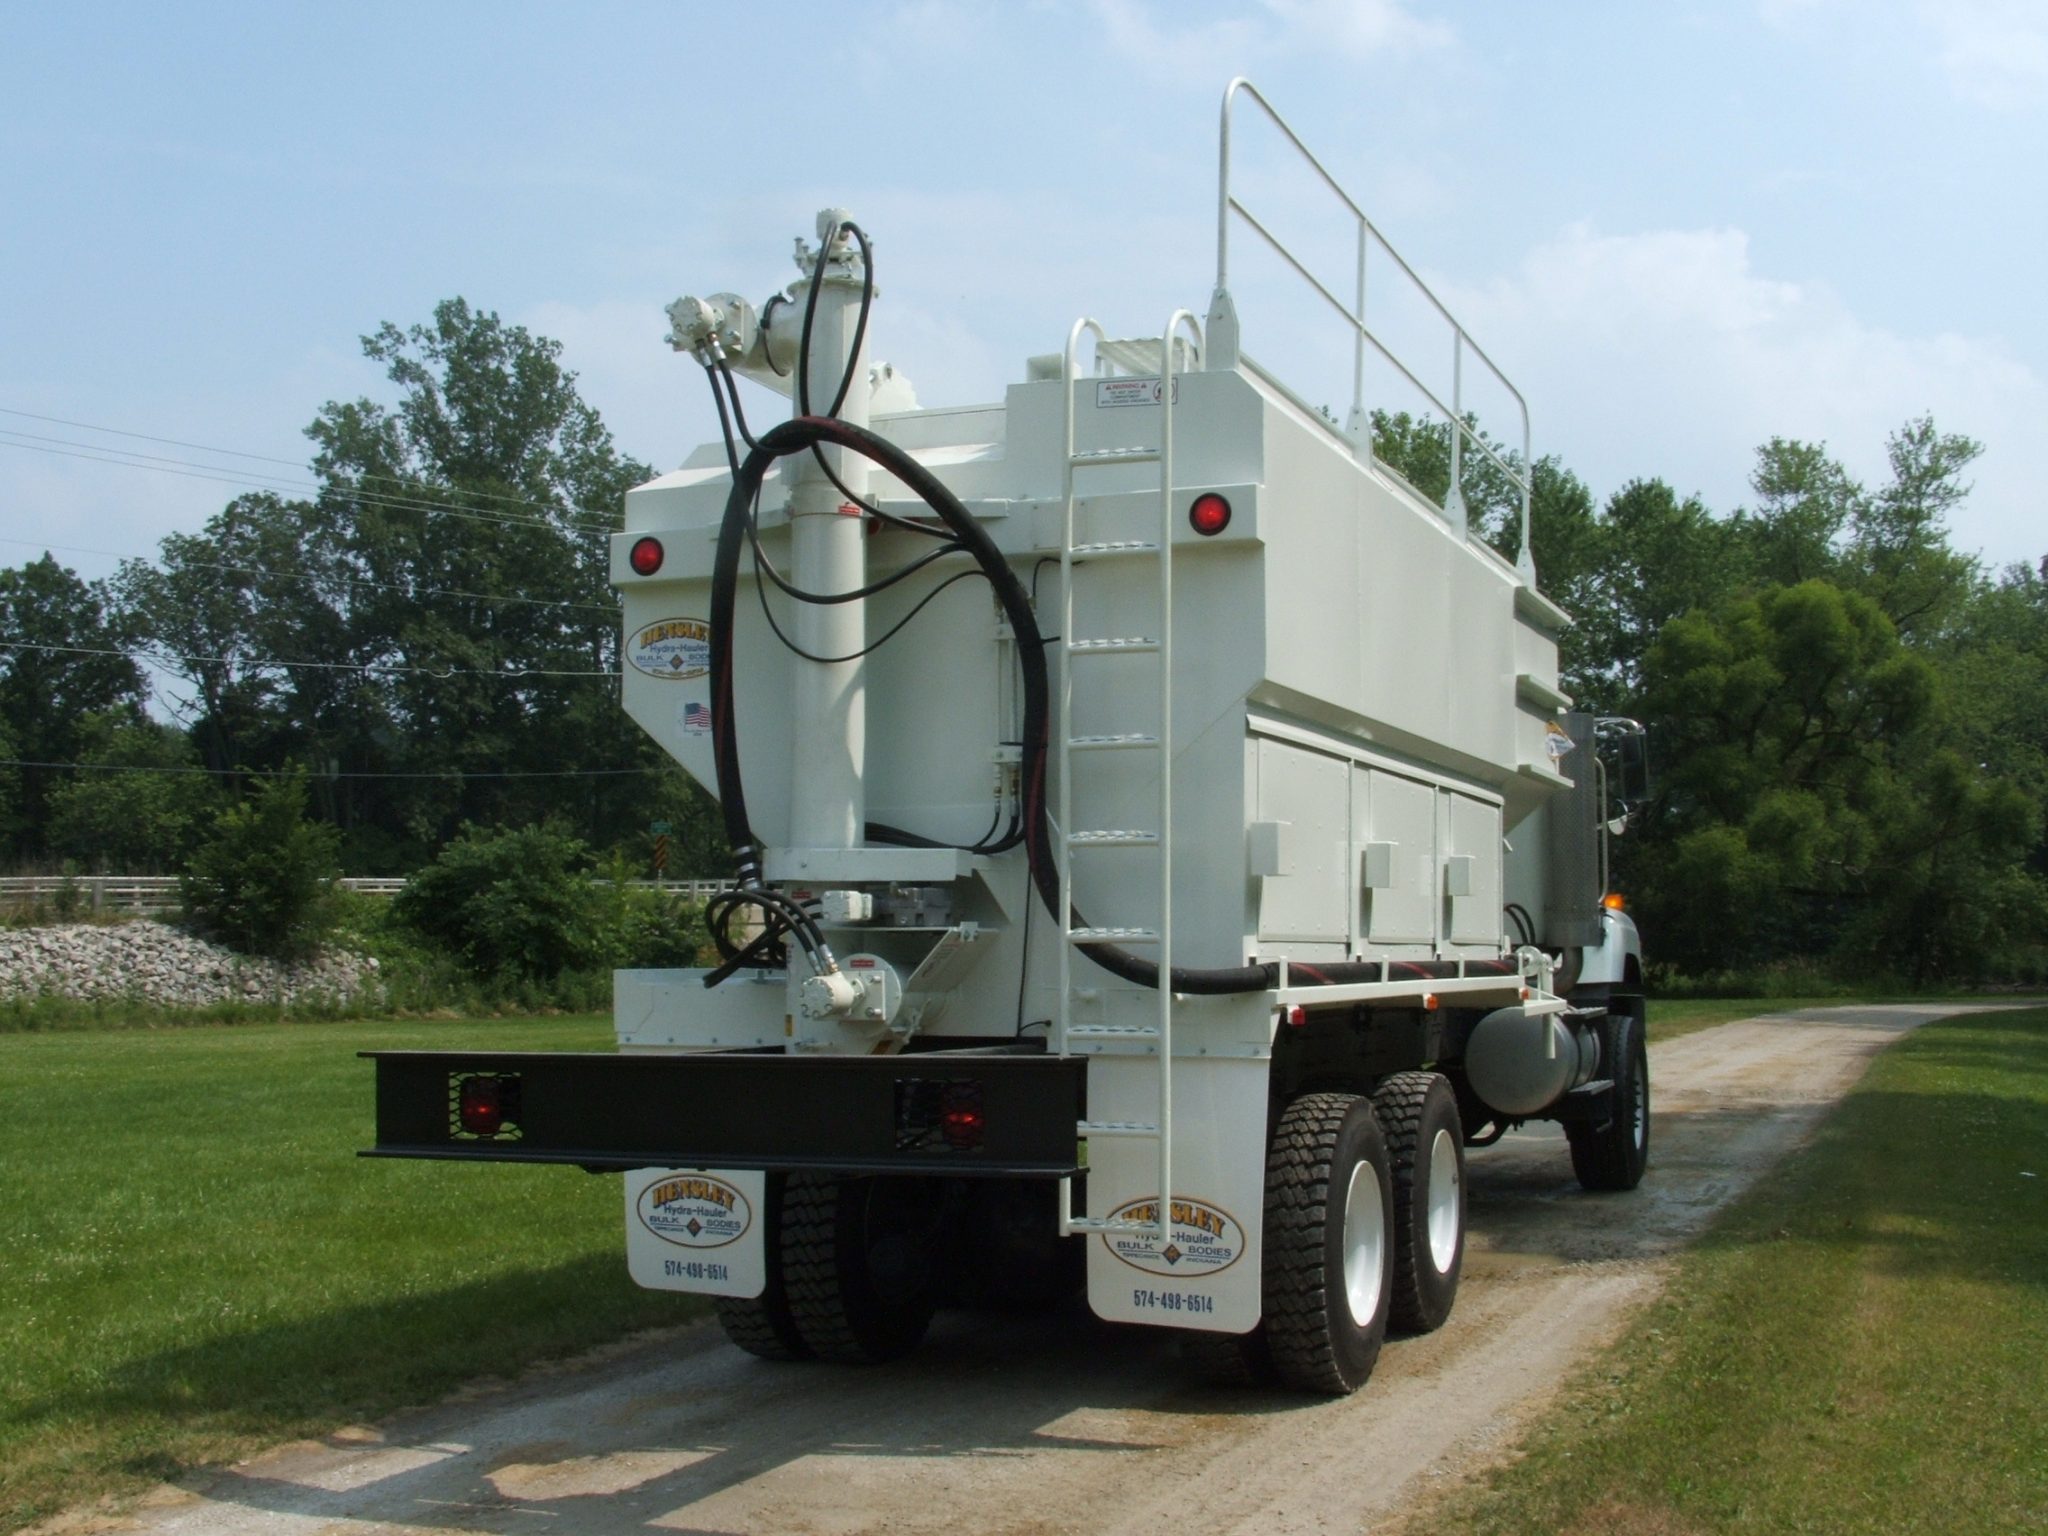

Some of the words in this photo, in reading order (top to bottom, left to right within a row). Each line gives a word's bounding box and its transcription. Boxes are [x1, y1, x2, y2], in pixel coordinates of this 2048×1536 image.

[640, 622, 710, 650] HENSLE
[652, 1179, 736, 1213] HENSLEY
[663, 1204, 727, 1218] Hydra-Hauler
[1135, 1231, 1215, 1245] y-Hauler
[1117, 1241, 1154, 1250] BULK
[1188, 1246, 1232, 1257] BODIES
[1134, 1289, 1213, 1313] 574-498-6514
